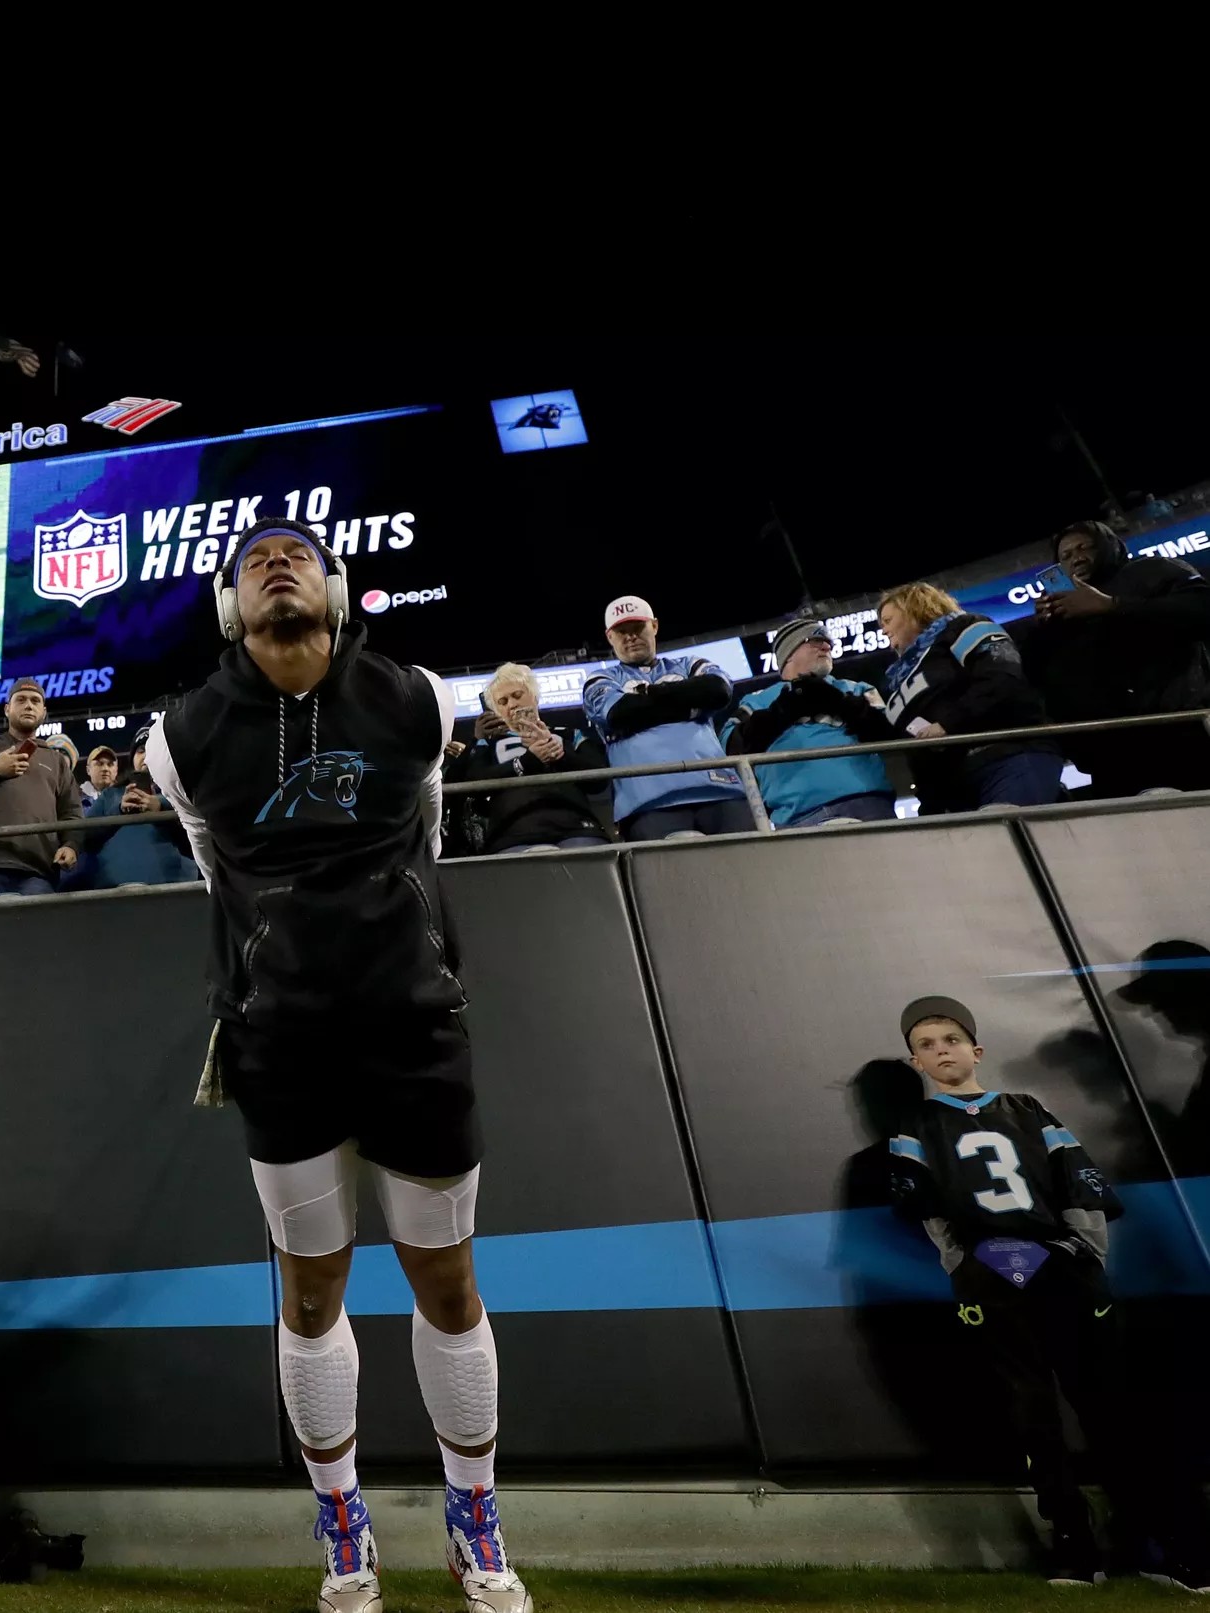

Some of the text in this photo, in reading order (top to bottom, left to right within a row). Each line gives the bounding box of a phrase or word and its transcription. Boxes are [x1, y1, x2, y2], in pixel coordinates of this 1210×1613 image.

[142, 486, 331, 544] WEEK 10
[140, 512, 415, 581] HIGGHTS
[47, 549, 115, 590] NFL
[392, 585, 447, 608] pepsi
[615, 603, 635, 616] NC
[848, 623, 865, 636] TO
[36, 722, 62, 737] WN
[87, 716, 126, 731] TO GO
[955, 1131, 1034, 1213] 3
